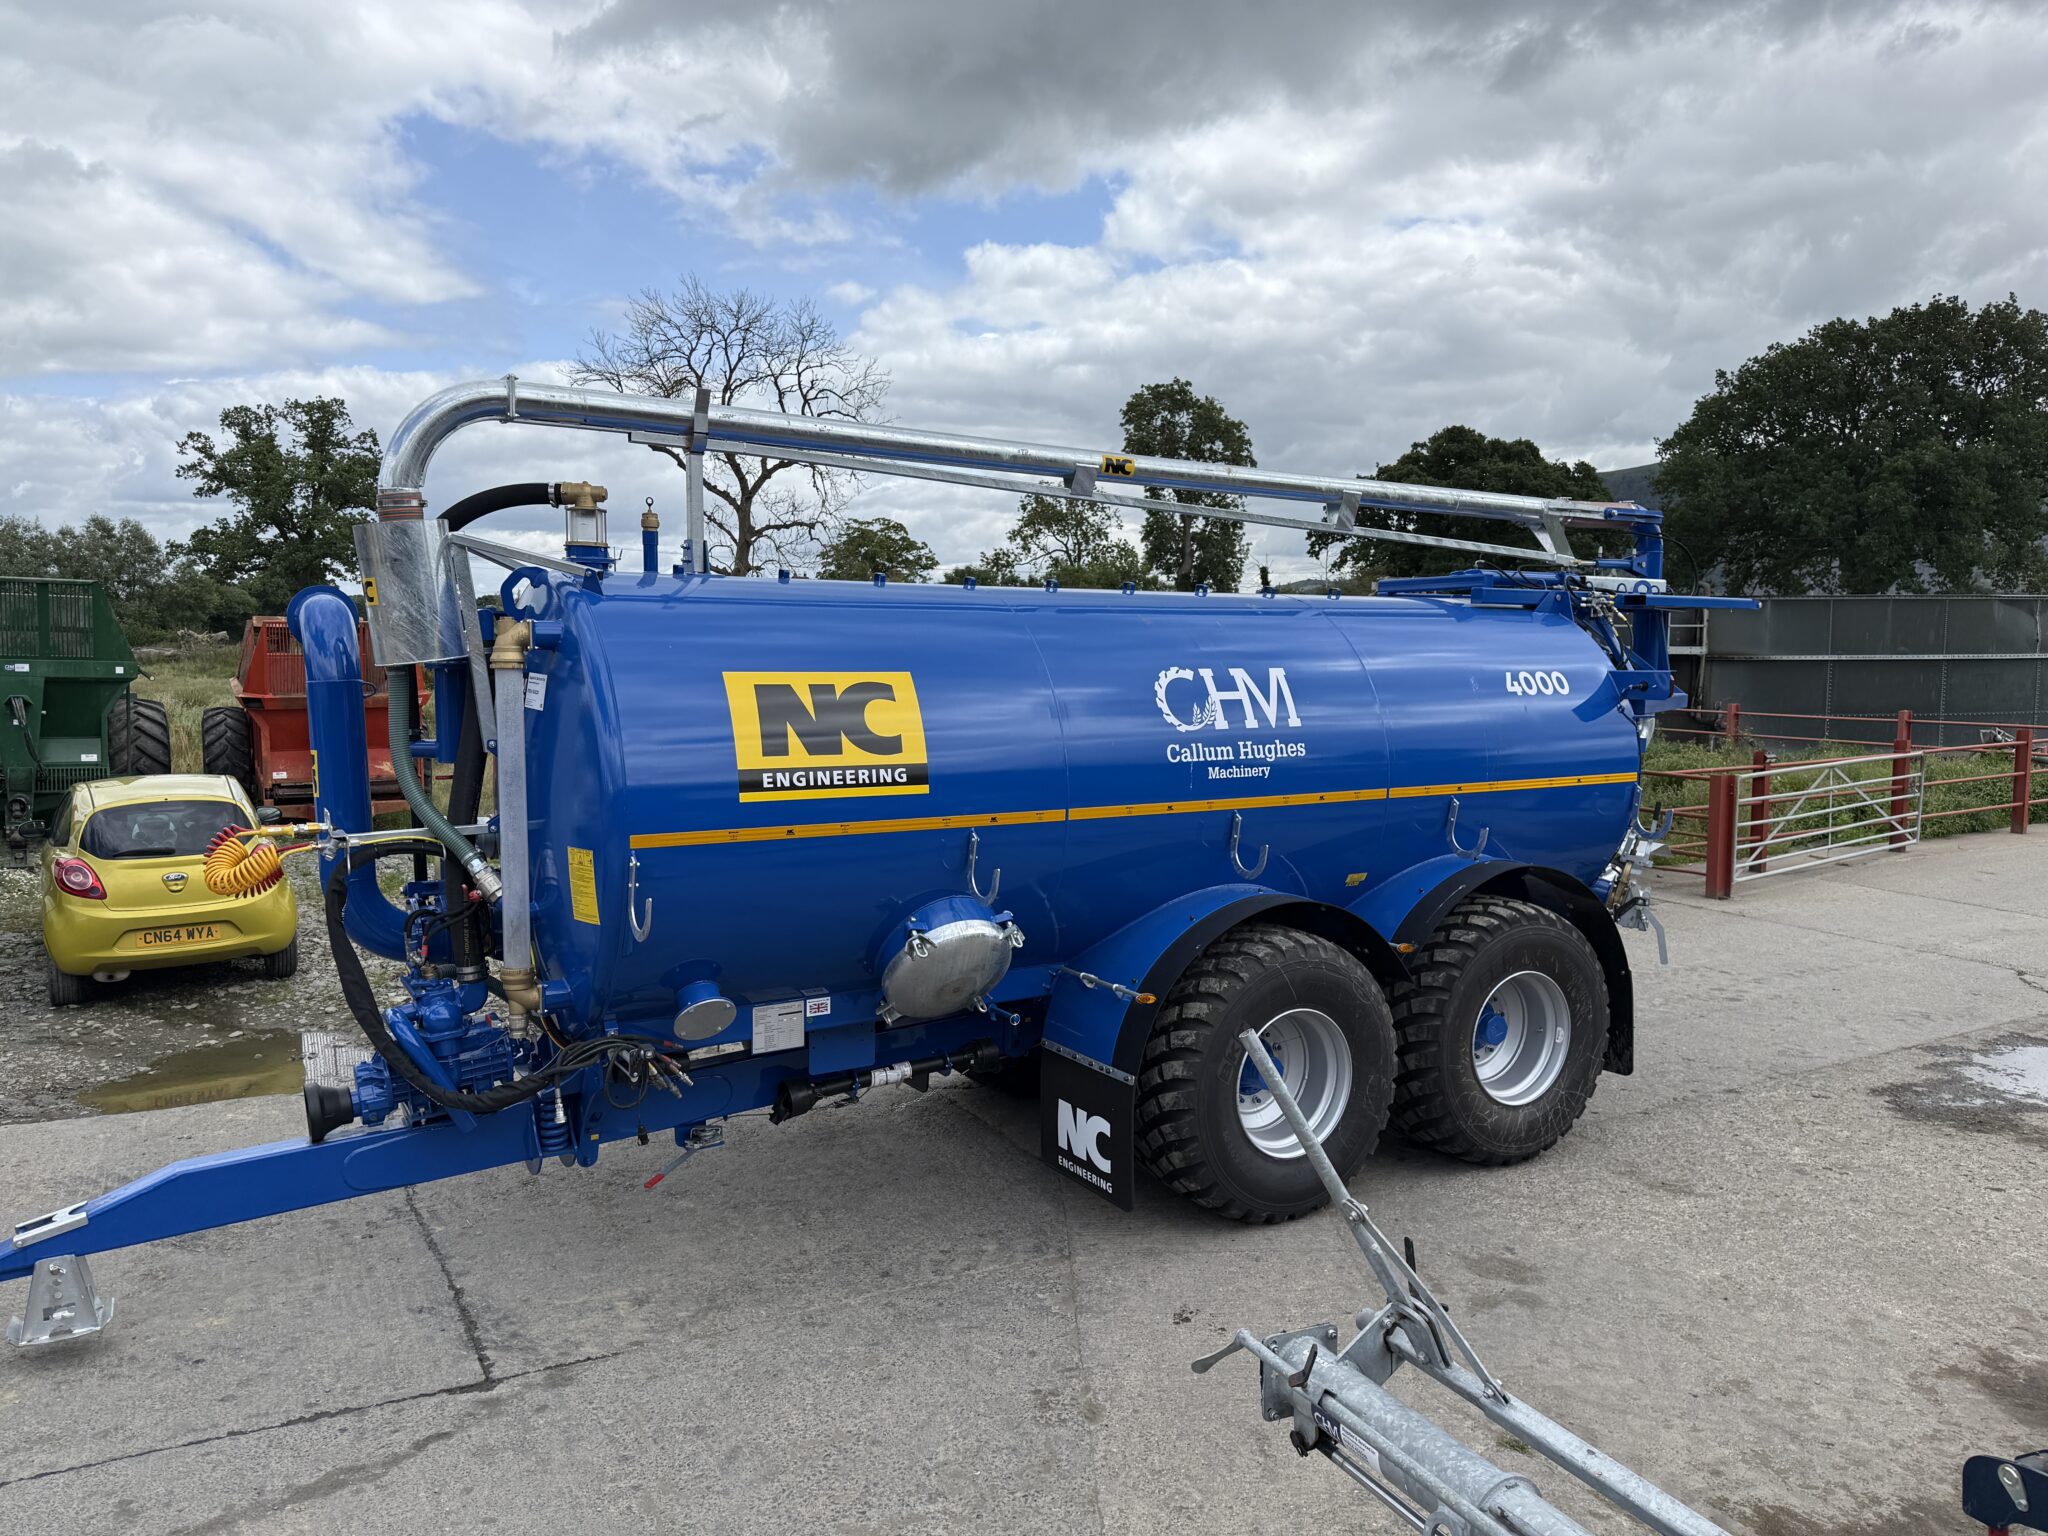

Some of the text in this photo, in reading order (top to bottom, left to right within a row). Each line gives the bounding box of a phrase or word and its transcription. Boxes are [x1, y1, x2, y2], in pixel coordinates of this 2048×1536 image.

[1104, 457, 1133, 476] NC
[1505, 670, 1570, 696] 4000
[1154, 666, 1302, 732] CHM
[754, 681, 903, 757] NC
[1166, 740, 1306, 763] Callum Hughes
[762, 767, 908, 788] ENGINEERING
[1207, 765, 1270, 779] Machinery
[143, 926, 214, 944] CN64 WYA
[1057, 1098, 1112, 1174] NC
[1058, 1155, 1113, 1194] ENGINEERING
[1313, 1411, 1340, 1440] CHM
